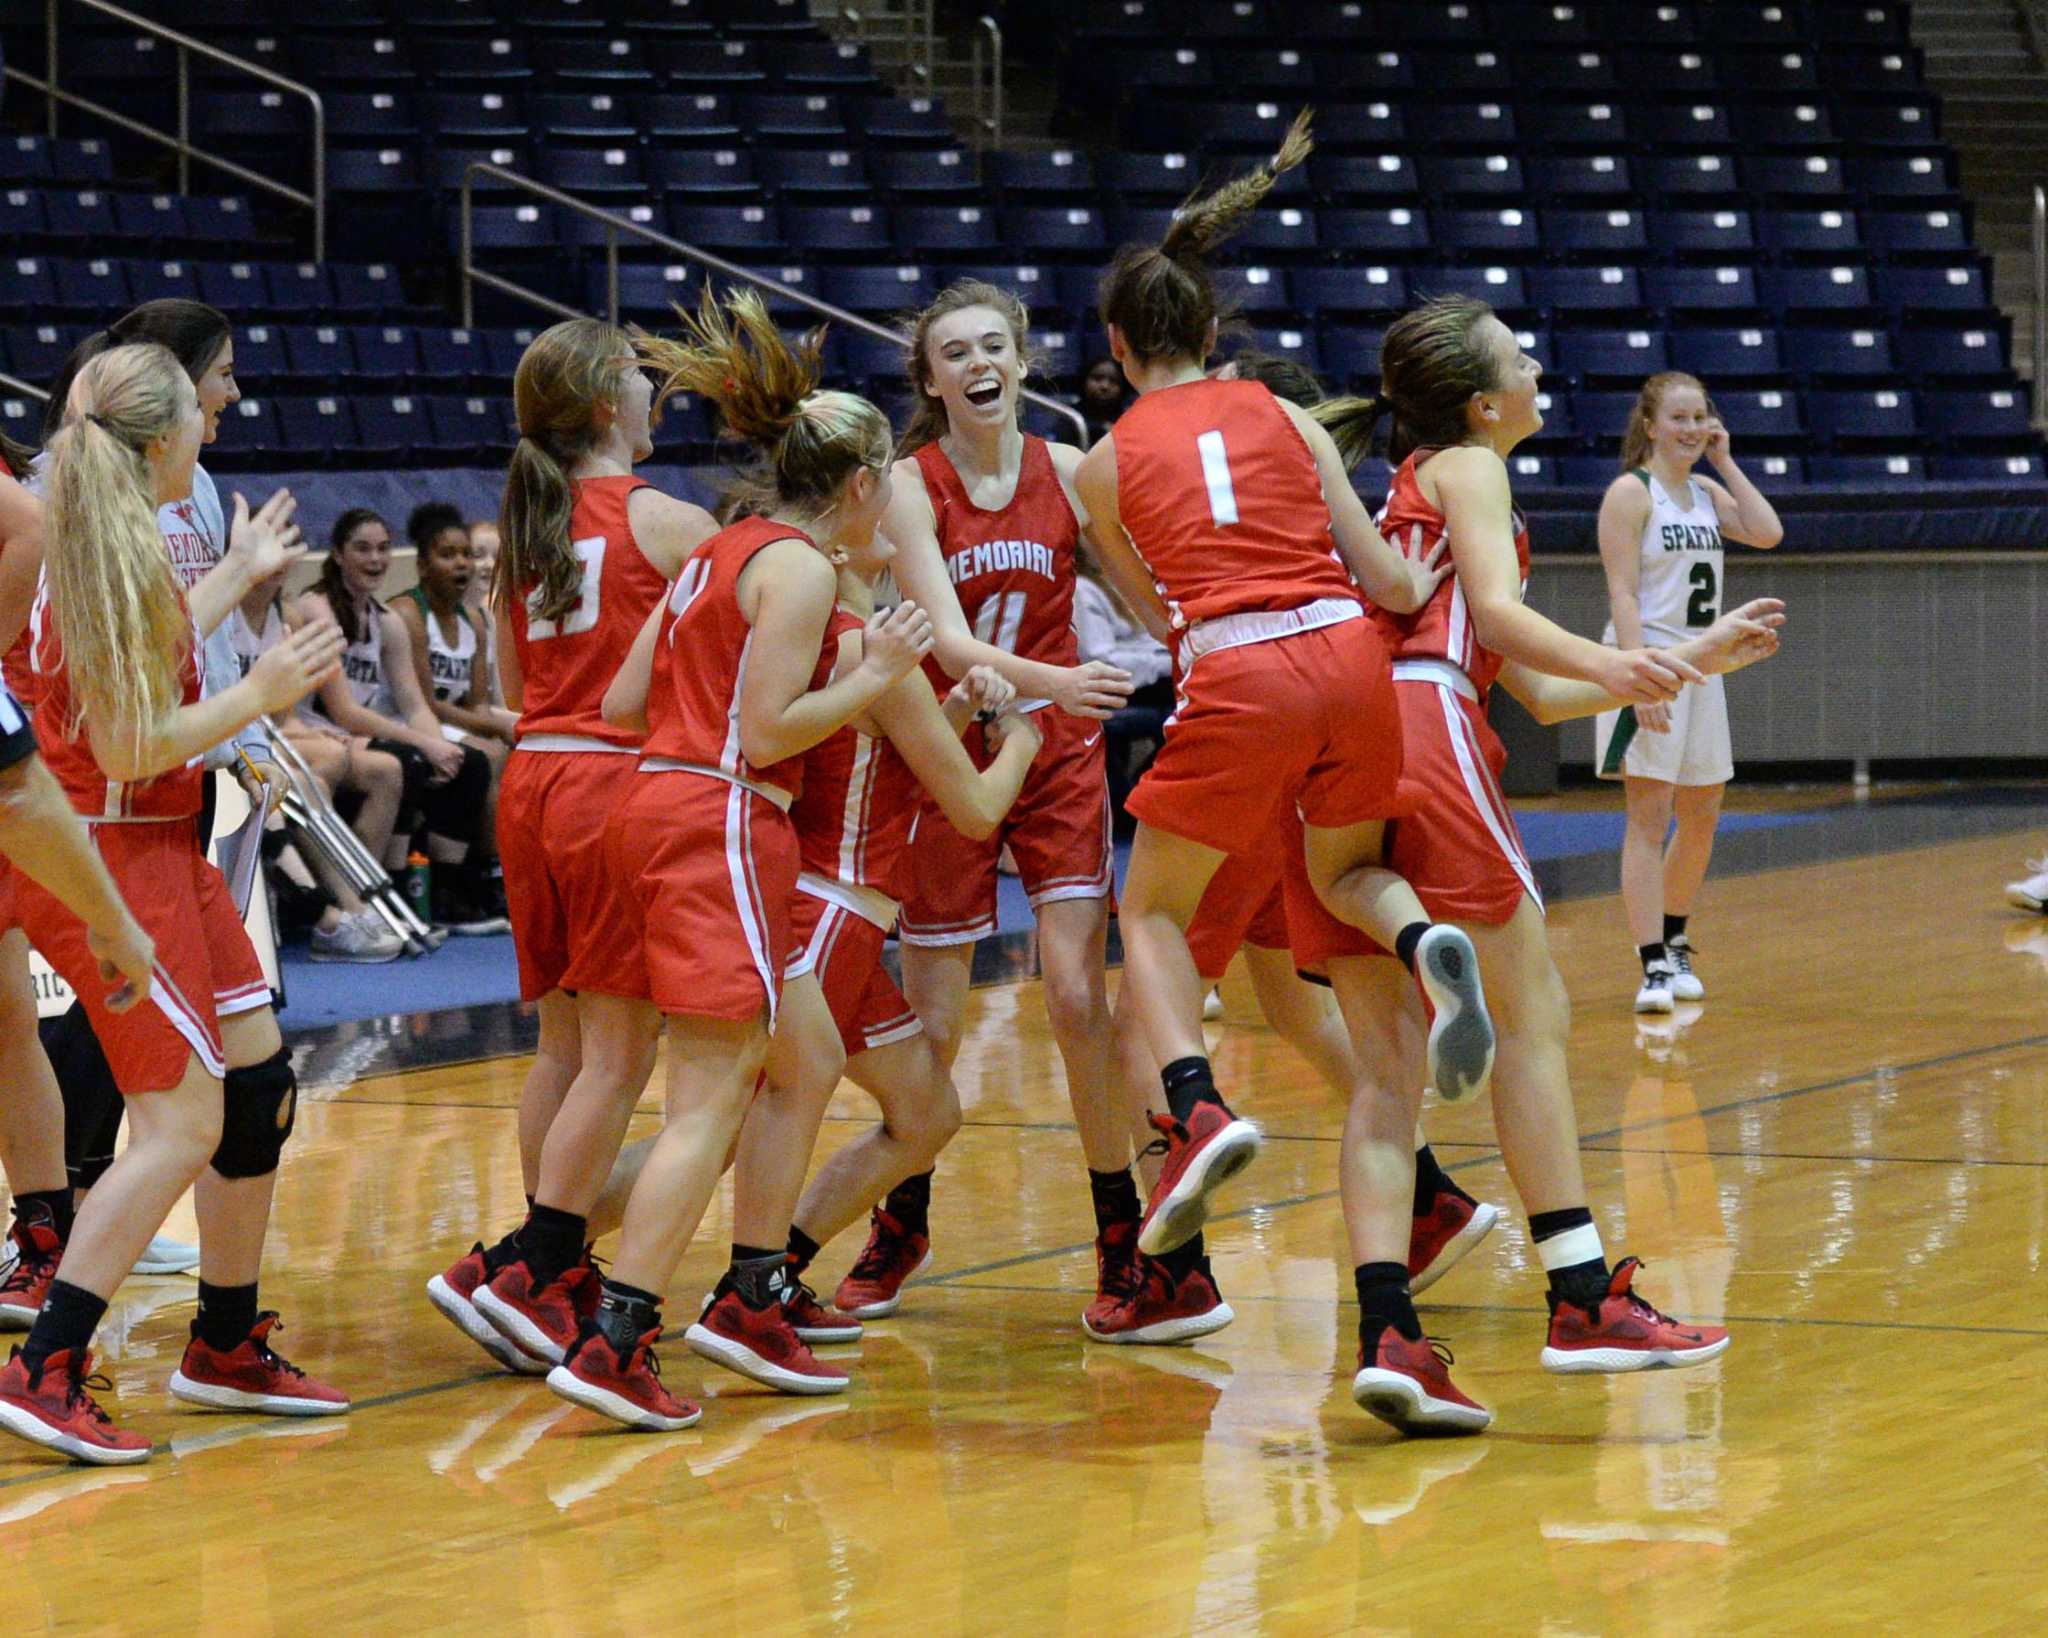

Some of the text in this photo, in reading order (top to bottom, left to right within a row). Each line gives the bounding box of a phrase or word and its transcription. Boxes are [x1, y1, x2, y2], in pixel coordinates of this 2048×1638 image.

[1197, 430, 1240, 528] 1
[164, 532, 218, 564] EMOR
[1661, 524, 1721, 551] SPARTA
[1686, 562, 1717, 628] 2
